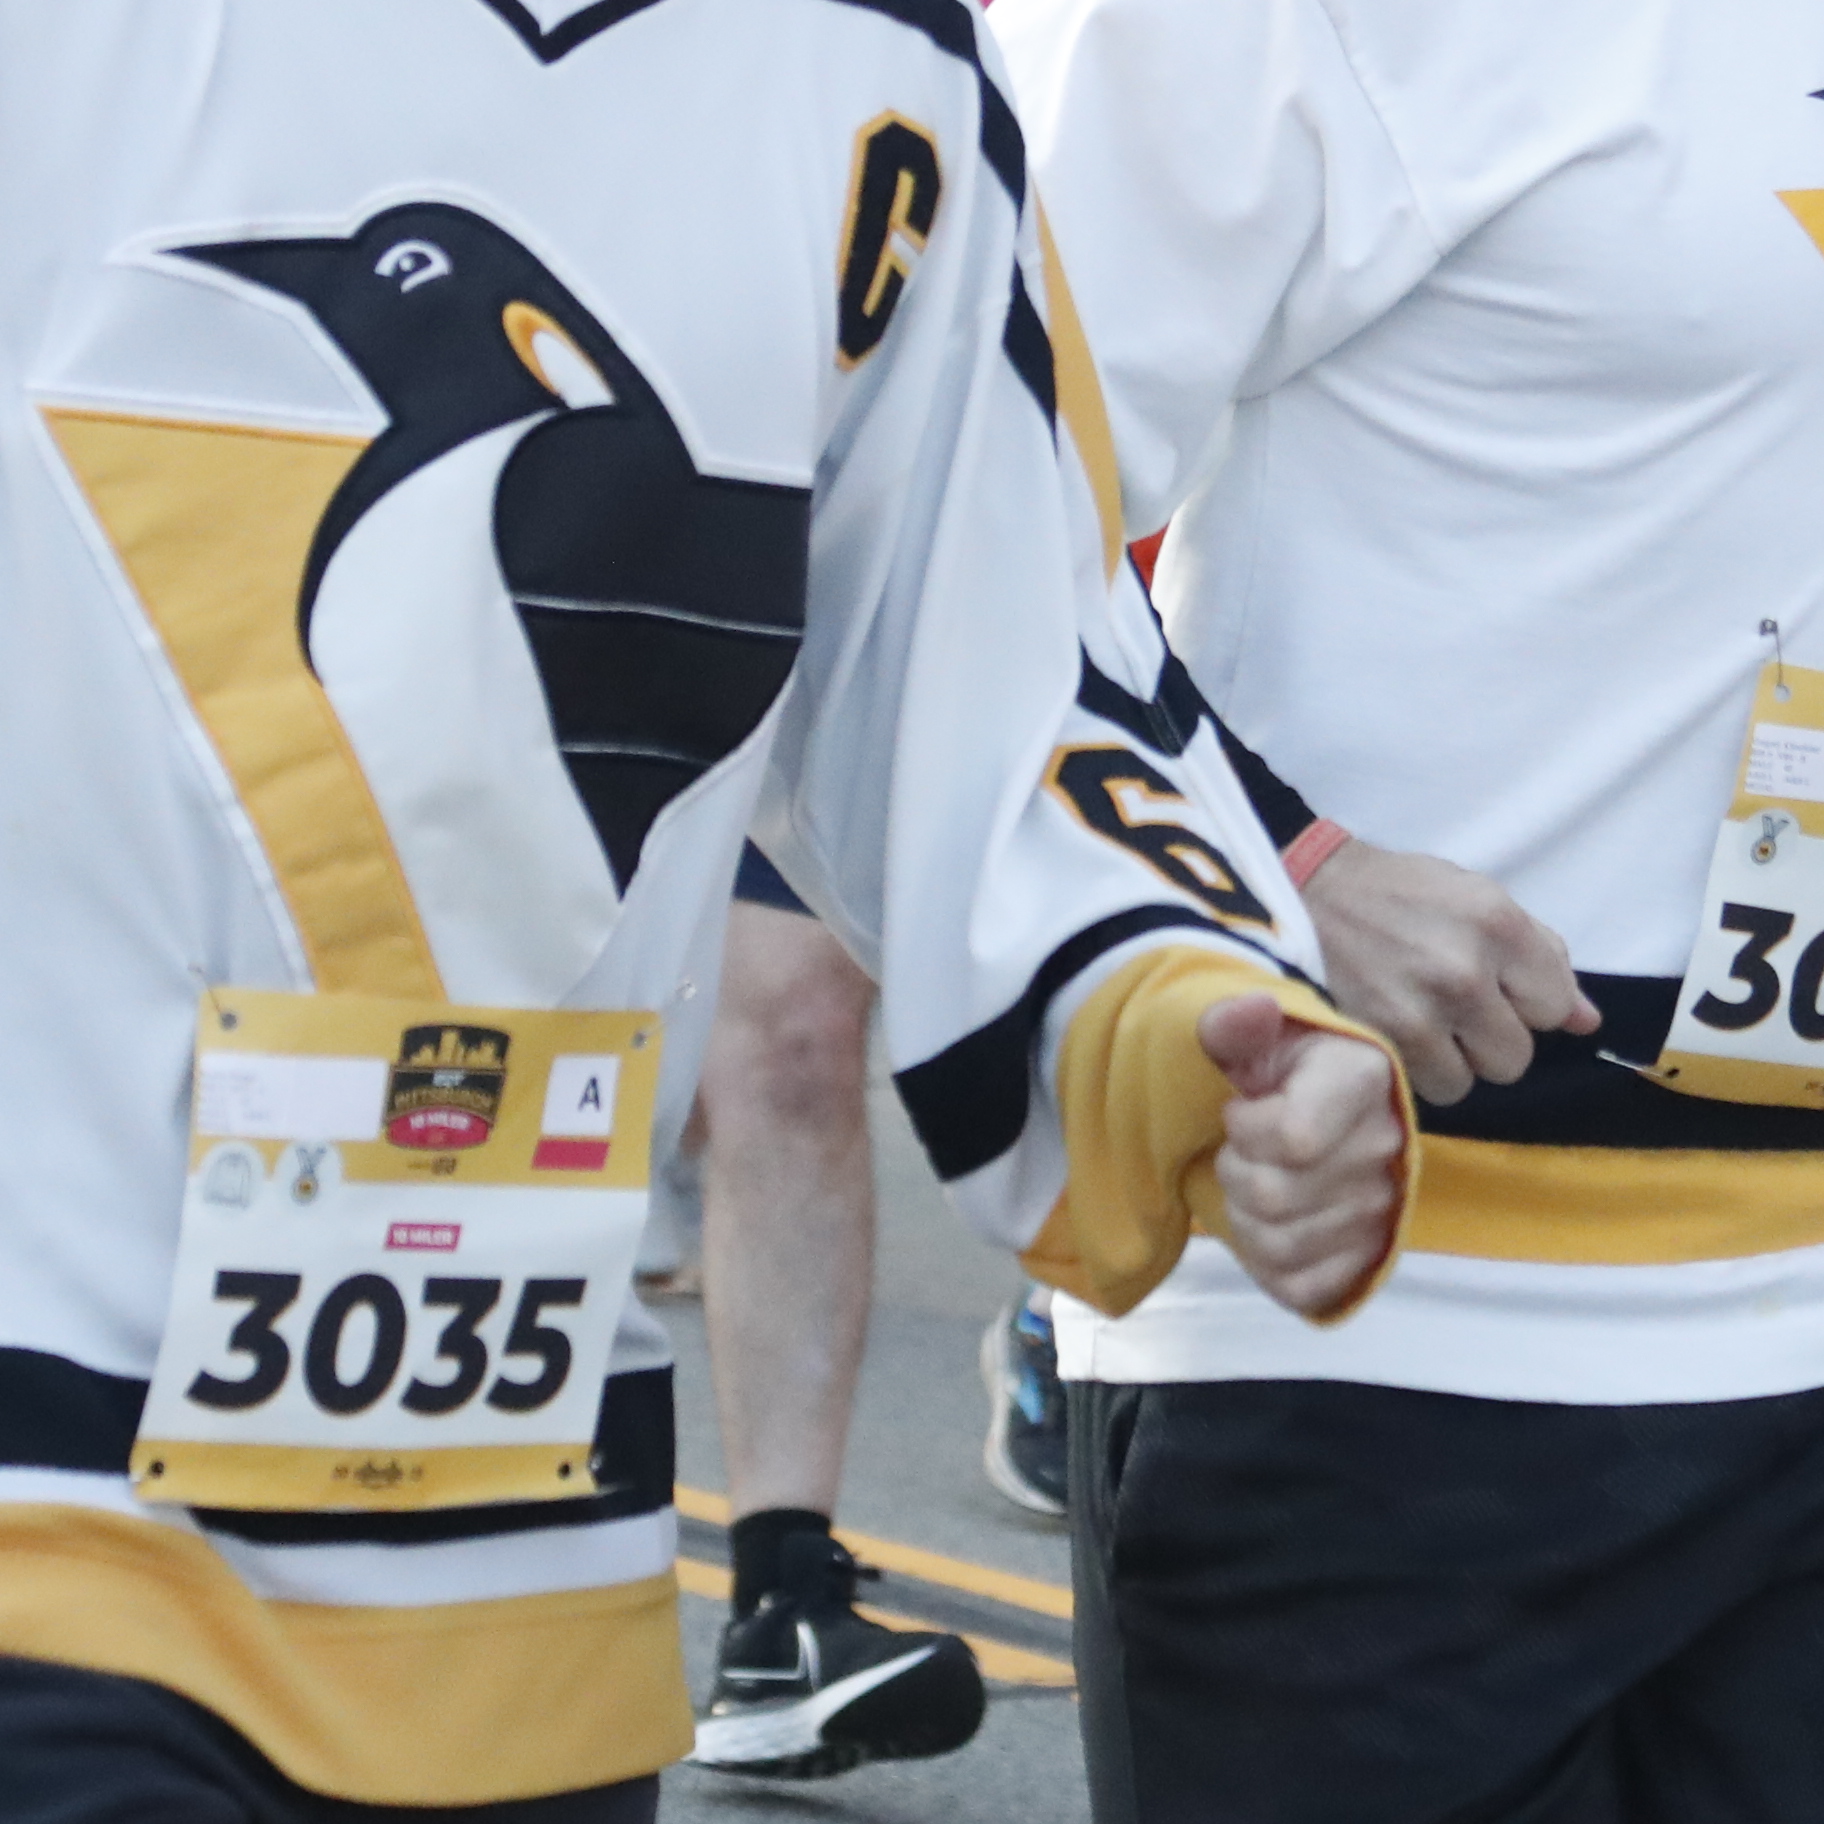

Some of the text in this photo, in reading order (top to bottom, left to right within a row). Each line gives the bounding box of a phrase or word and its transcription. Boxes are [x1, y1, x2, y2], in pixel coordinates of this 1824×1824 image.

[835, 108, 944, 373] C
[578, 1076, 601, 1111] A
[183, 1270, 588, 1417] 3035
